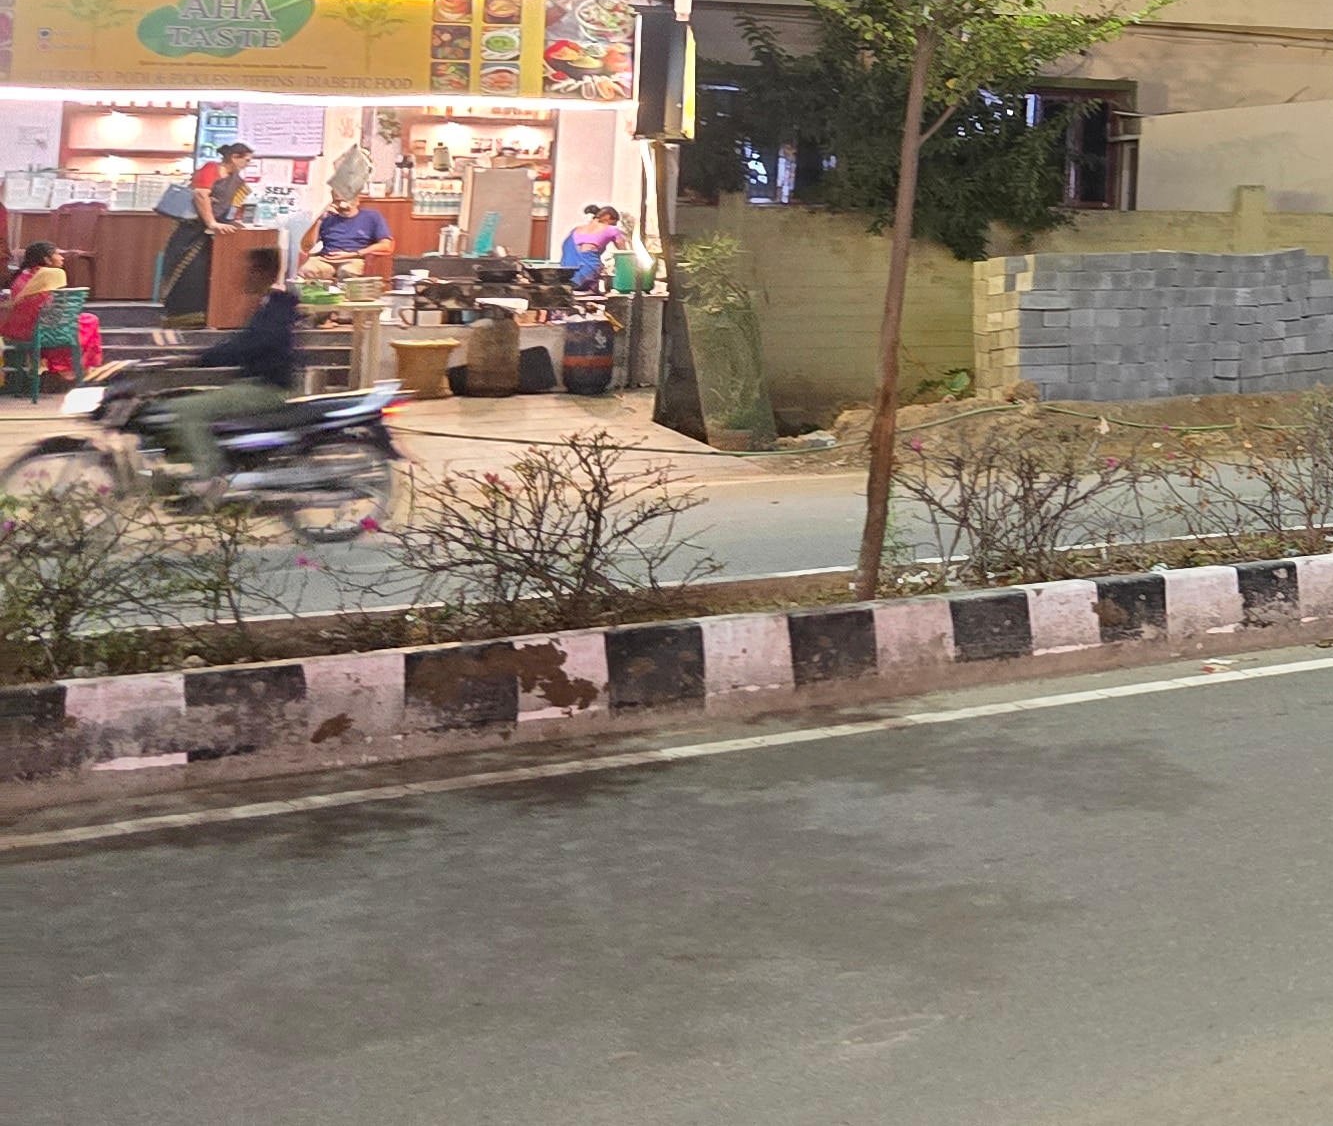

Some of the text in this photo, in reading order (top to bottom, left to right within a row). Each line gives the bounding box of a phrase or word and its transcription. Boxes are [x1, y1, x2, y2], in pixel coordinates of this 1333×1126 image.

[166, 26, 282, 49] TASTE
[306, 76, 371, 89] DIABETIC
[375, 77, 413, 89] FOOD
[265, 186, 295, 195] SELF
